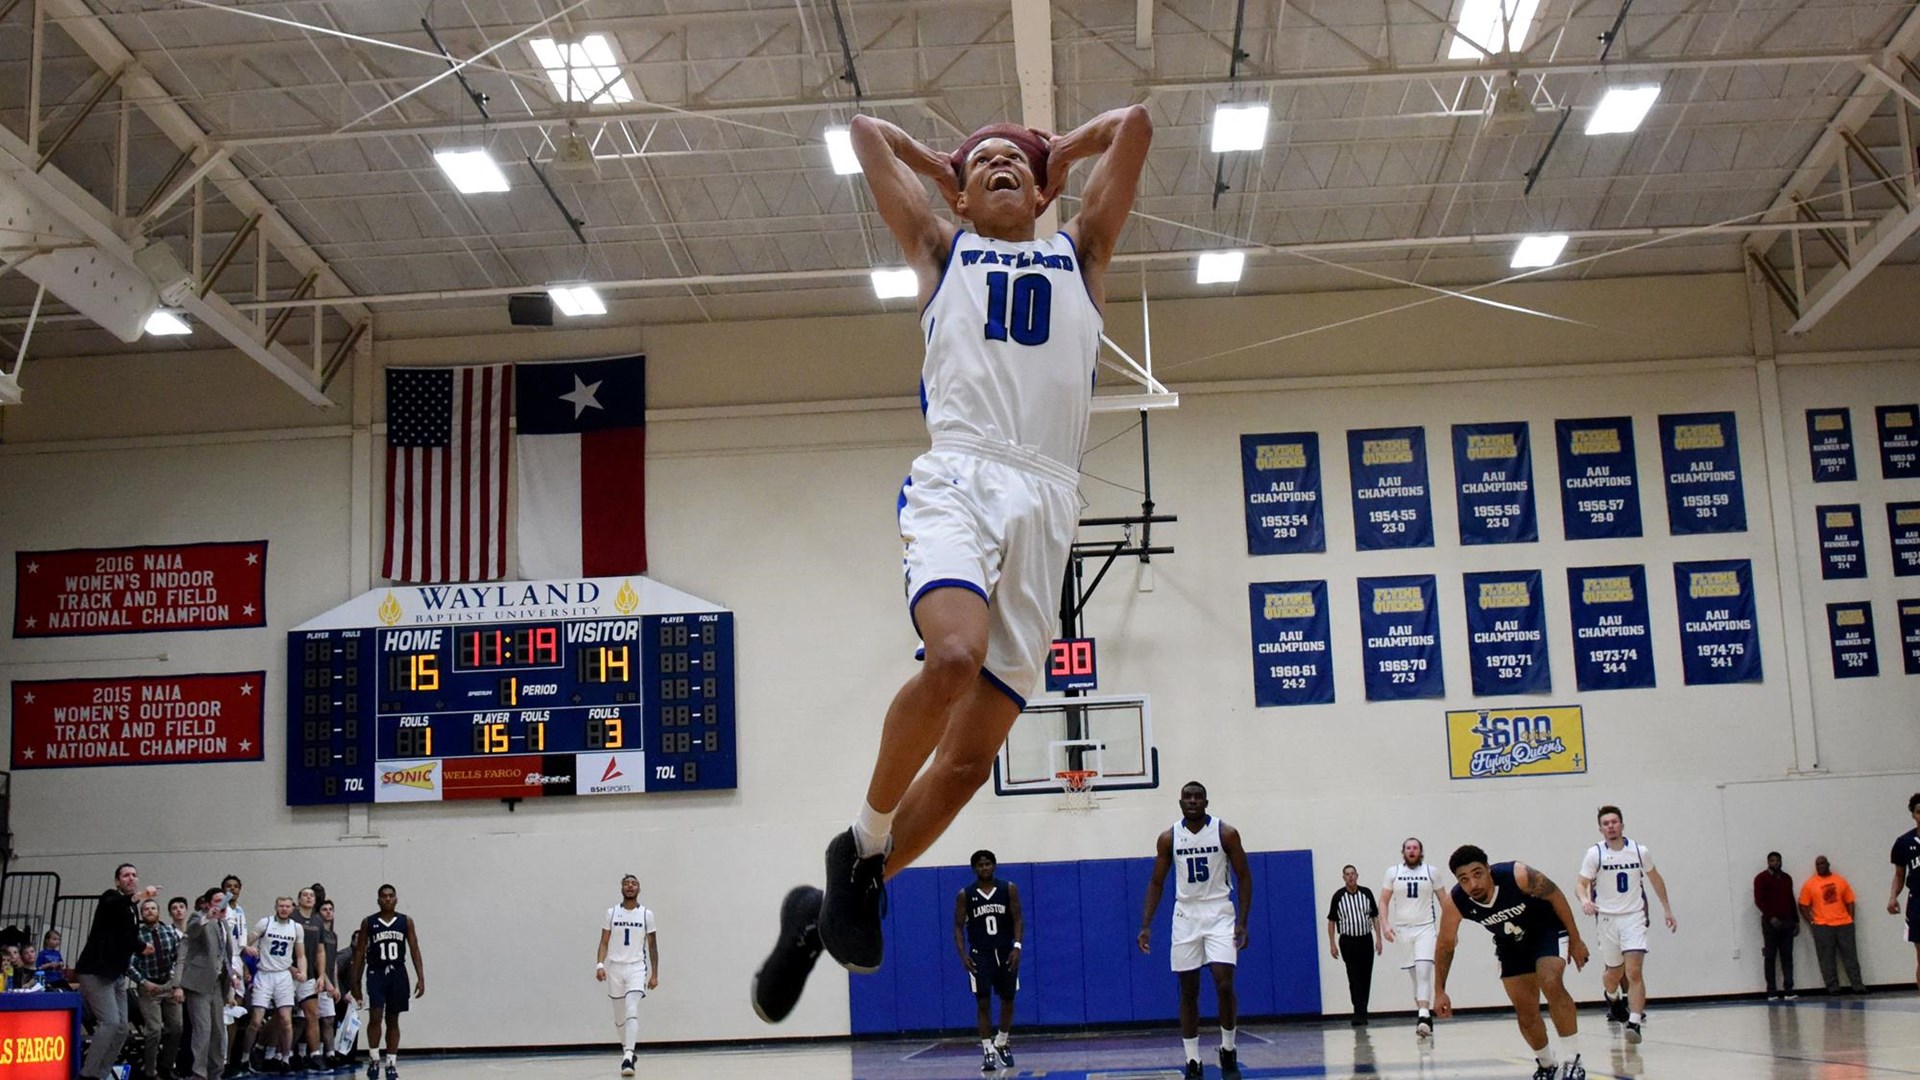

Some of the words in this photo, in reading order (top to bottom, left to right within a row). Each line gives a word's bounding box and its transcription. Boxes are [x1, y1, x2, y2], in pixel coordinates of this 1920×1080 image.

[960, 249, 1074, 272] WAYLAND
[984, 271, 1052, 346] 10
[1586, 466, 1610, 477] AAU
[1690, 461, 1713, 472] AAU
[1378, 476, 1402, 487] AAU
[1482, 471, 1506, 482] AAU
[1566, 476, 1632, 488] CHAMPIONS
[1671, 471, 1735, 483] CHAMPIONS
[1271, 482, 1294, 492] AAU
[1358, 486, 1424, 499] CHAMPIONS
[1462, 481, 1528, 493] CHAMPIONS
[1250, 491, 1316, 504] CHAMPIONS
[1682, 494, 1729, 507] 1958-59
[1473, 505, 1521, 517] 1955-56
[1578, 499, 1624, 512] 1956-57
[1369, 510, 1416, 523] 1954-55
[1696, 507, 1718, 518] 30-1
[1261, 514, 1308, 527] 1953-54
[1486, 518, 1510, 528] 23-0
[1382, 523, 1405, 533] 23-0
[96, 556, 133, 573] 2016
[144, 554, 183, 570] NAIA
[65, 573, 140, 592] WOMEN'S
[151, 571, 214, 588] INDOOR
[58, 592, 112, 610] TRACK
[123, 590, 157, 607] AND
[167, 588, 217, 605] FIELD
[416, 582, 600, 611] WAYLAND
[49, 610, 132, 628] NATIONAL
[142, 605, 229, 625] CHAMPION
[415, 612, 484, 623] BAPTIST
[495, 606, 600, 619] UNIVERSITY
[699, 614, 718, 622] FOULS
[1599, 615, 1623, 626] AAU
[1705, 610, 1729, 621] AAU
[567, 621, 639, 643] VISITOR
[1388, 625, 1412, 637] AAU
[1494, 620, 1518, 631] AAU
[1578, 625, 1645, 638] CHAMPIONS
[1686, 619, 1751, 632] CHAMPIONS
[384, 630, 443, 651] HOME
[1279, 631, 1303, 642] AAU
[1368, 635, 1434, 648] CHAMPIONS
[1474, 630, 1540, 643] CHAMPIONS
[473, 627, 557, 667] 11:19
[1258, 641, 1325, 653] CHAMPIONS
[1697, 644, 1744, 656] 1974-75
[1050, 641, 1092, 676] 30
[1486, 654, 1532, 667] 1970-71
[1590, 649, 1637, 662] 1973-74
[1711, 657, 1732, 667] 34-1
[600, 646, 628, 683] 14
[1379, 659, 1427, 672] 1969-70
[1603, 662, 1627, 673] 34-4
[410, 654, 439, 691] 15
[1270, 665, 1317, 678] 1960-61
[1392, 673, 1415, 683] 27-3
[1499, 668, 1522, 678] 30-2
[522, 684, 557, 696] PERIOD
[1282, 678, 1306, 689] 24-2
[93, 687, 131, 703] 2015
[142, 685, 181, 701] NAIA
[511, 677, 517, 705] 1
[54, 704, 129, 722] WOMEN'S
[140, 701, 221, 718] OUTDOOR
[520, 710, 550, 722] FOULS
[589, 708, 619, 719] FOULS
[400, 716, 429, 727] FOULS
[472, 713, 510, 724] PLAYER
[55, 723, 110, 741] TRACK
[121, 721, 155, 737] AND
[165, 719, 216, 735] FIELD
[538, 722, 544, 751] 1
[605, 719, 622, 748] 3
[425, 727, 432, 756] 1
[484, 724, 509, 753] 15
[46, 742, 130, 760] NATIONAL
[140, 737, 227, 756] CHAMPION
[1470, 745, 1513, 775] Flying
[1512, 738, 1565, 765] Queens
[382, 769, 432, 784] SONIC
[443, 771, 482, 780] WELLS
[484, 768, 521, 778] FARGO
[656, 766, 676, 779] TOL
[344, 778, 364, 791] TOL
[1176, 845, 1219, 856] WAYLAND
[1186, 857, 1210, 883] 15
[1602, 862, 1640, 871] WAYLAND
[1616, 872, 1629, 893] 0
[1406, 882, 1419, 898] 11
[973, 903, 1006, 918] LANGSTON
[985, 916, 998, 936] 0
[1504, 921, 1523, 936] 4
[373, 930, 404, 943] LANGSTON
[623, 928, 630, 946] 1
[270, 940, 289, 957] 23
[379, 942, 399, 961] 10
[16, 1036, 65, 1063] FARGO
